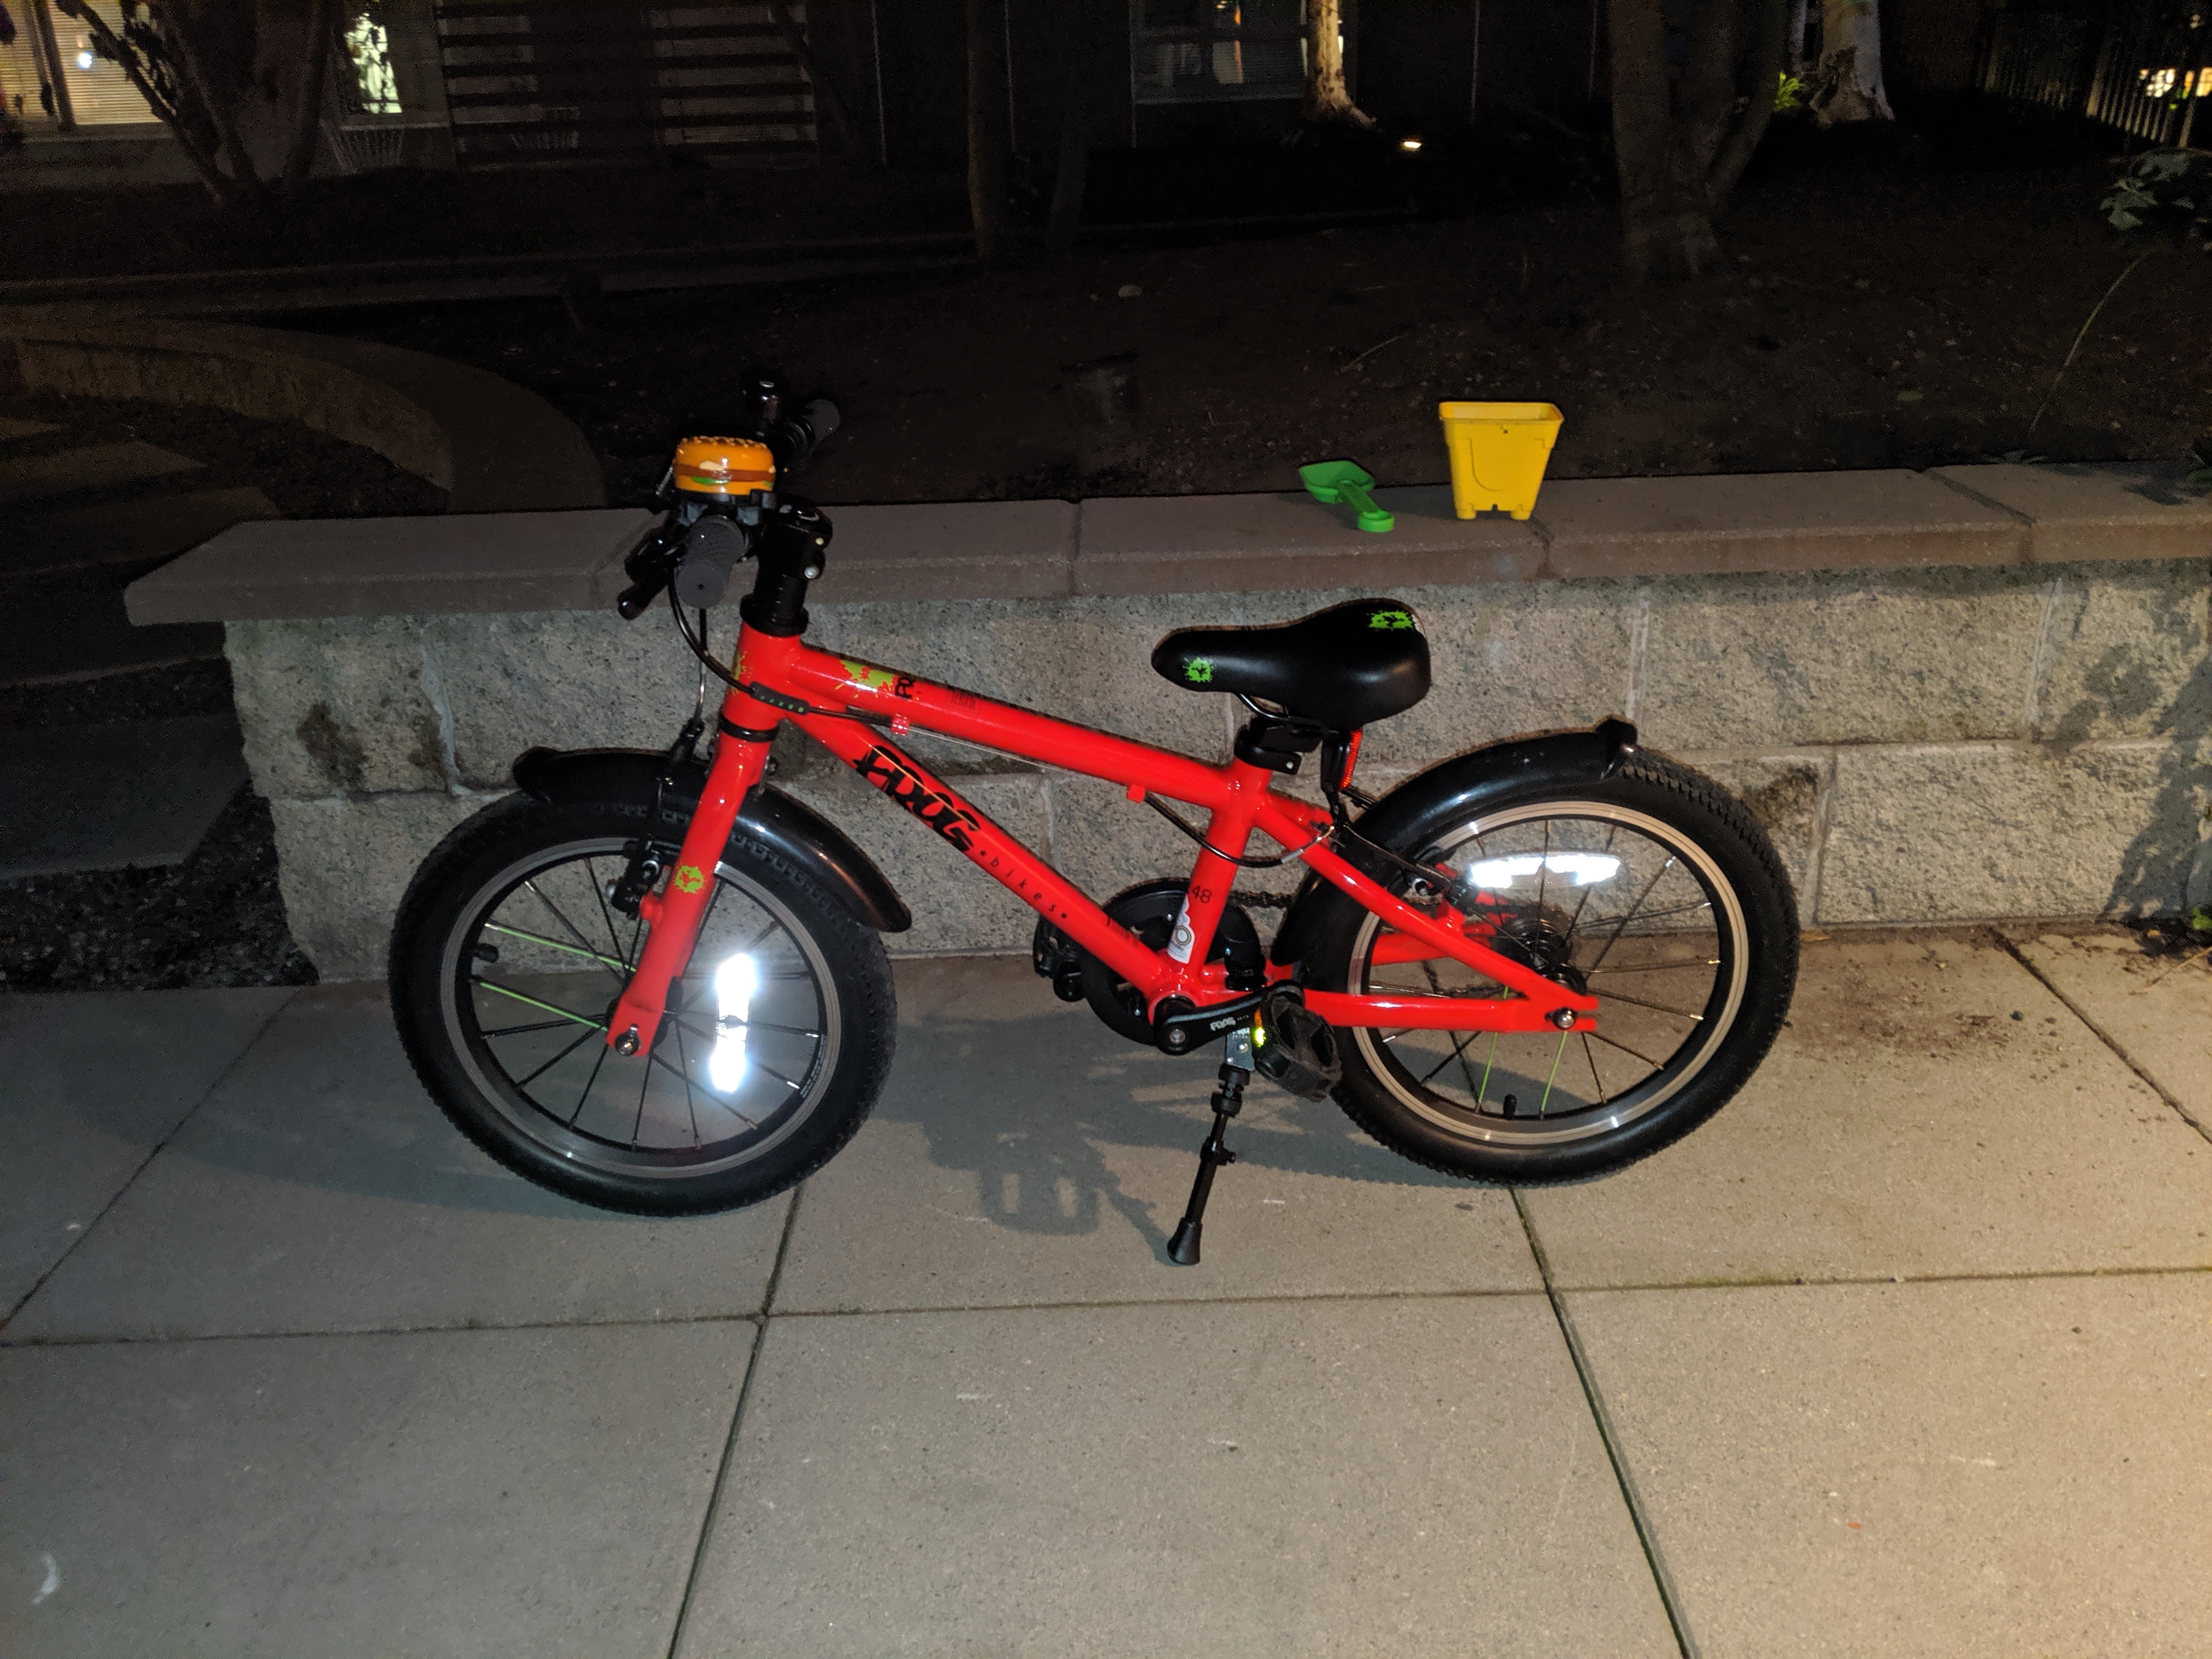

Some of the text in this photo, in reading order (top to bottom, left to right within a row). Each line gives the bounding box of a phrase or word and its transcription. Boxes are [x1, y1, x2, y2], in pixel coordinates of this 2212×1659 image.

[853, 745, 1057, 913] FROG bikes
[1192, 885, 1212, 904] 48
